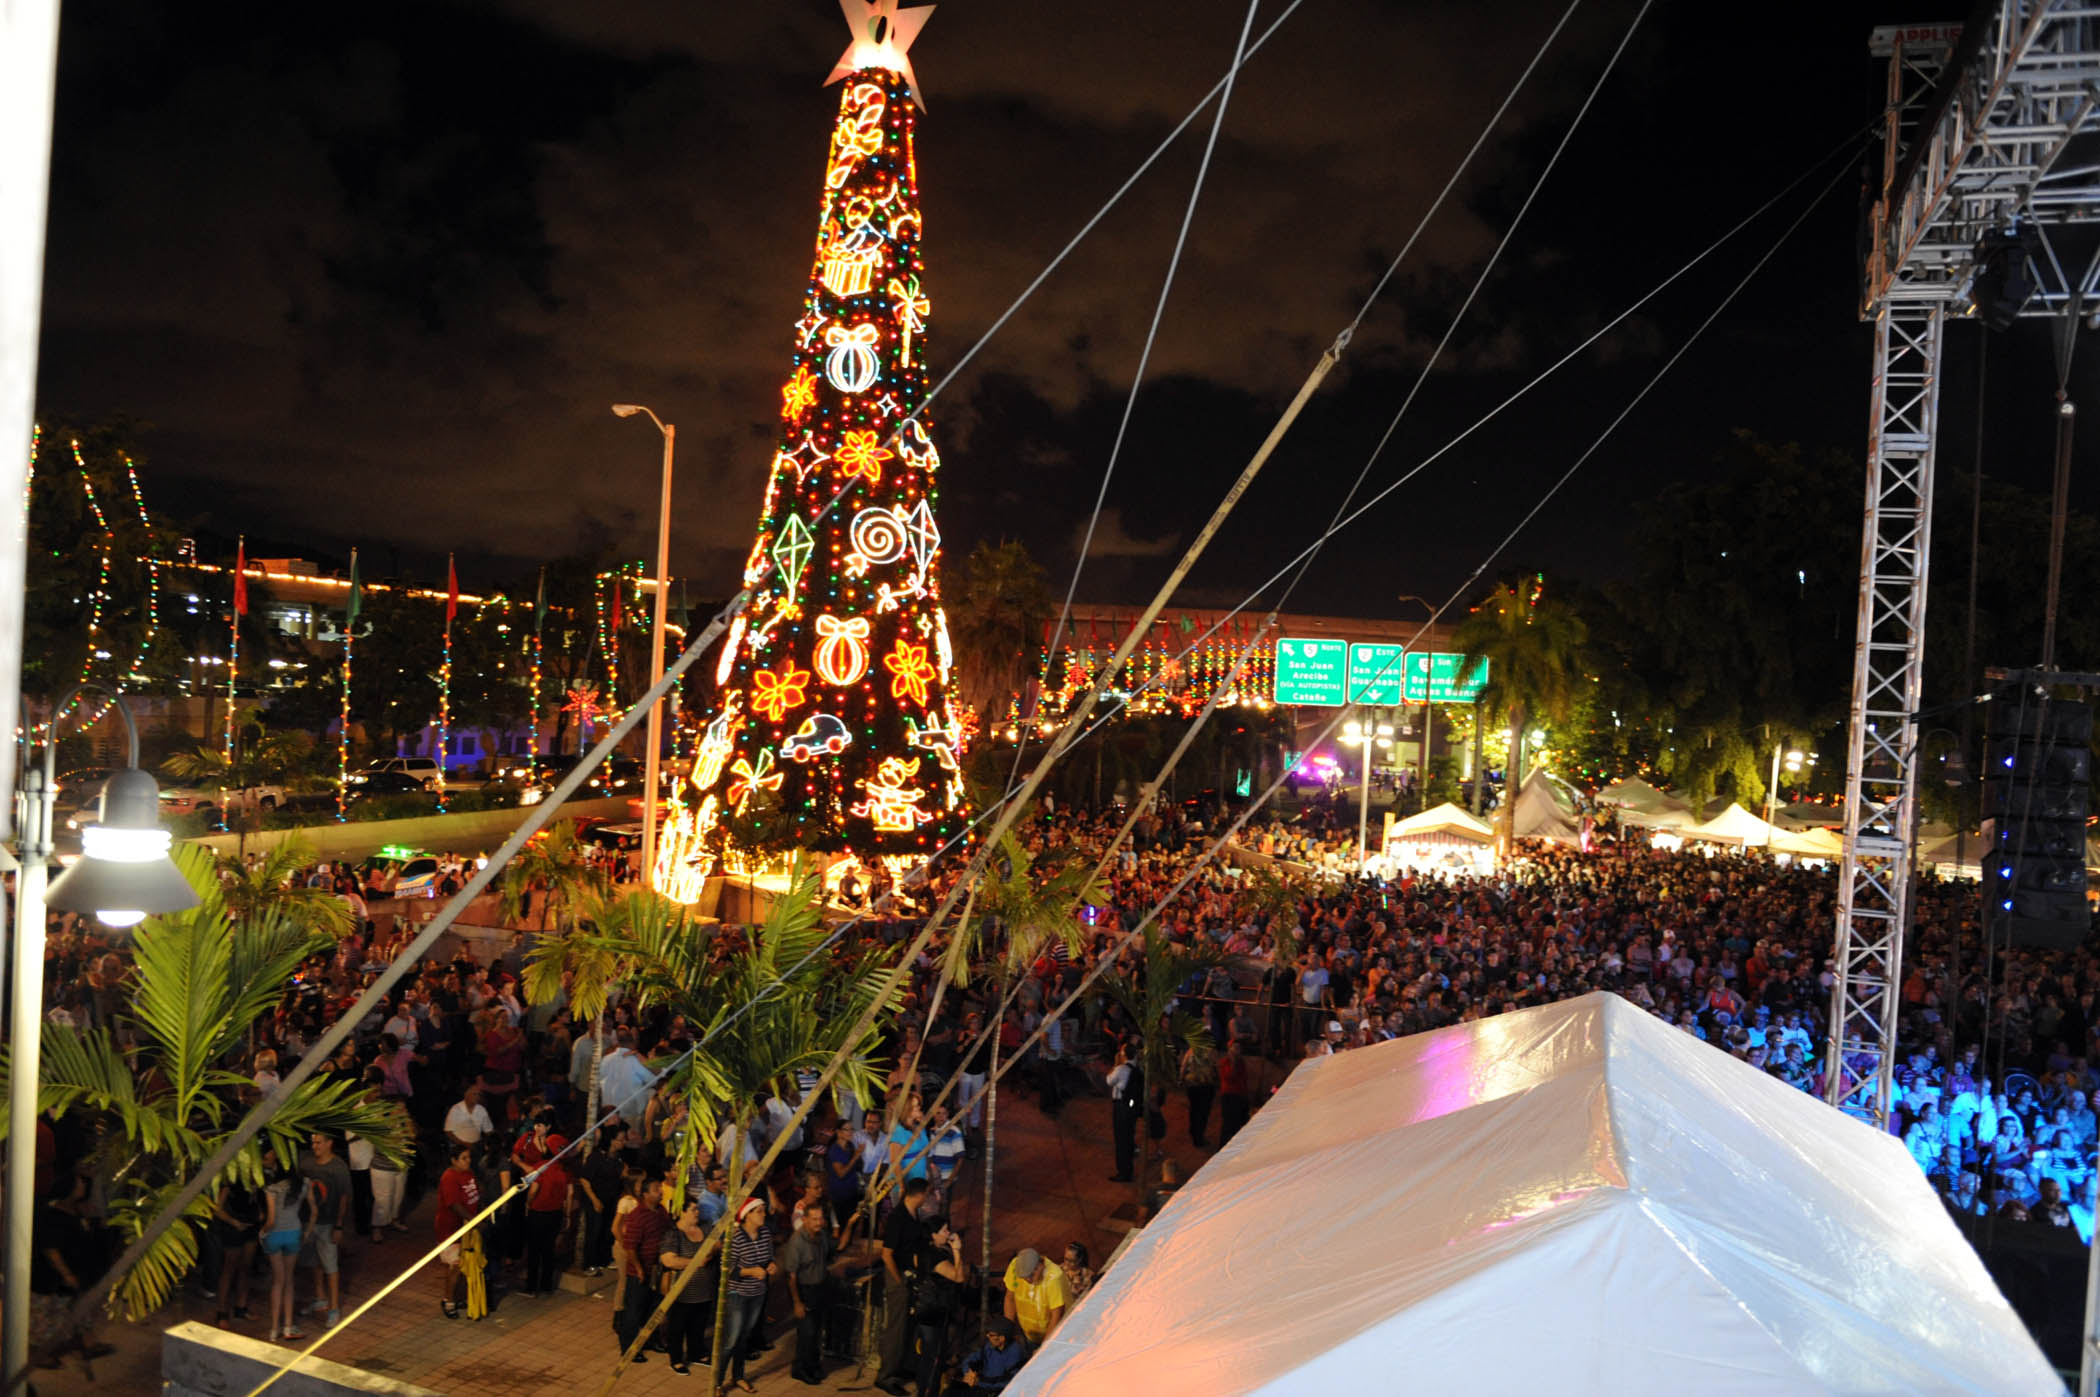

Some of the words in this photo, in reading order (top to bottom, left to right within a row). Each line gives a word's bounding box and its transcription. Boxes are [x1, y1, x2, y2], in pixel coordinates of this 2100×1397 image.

[1307, 645, 1314, 655] 5
[1361, 650, 1369, 660] 2
[1289, 660, 1306, 669] San
[1310, 661, 1334, 670] Juan
[1353, 666, 1371, 674] San
[1293, 671, 1329, 681] Arecibo
[1412, 675, 1457, 686] Baamón
